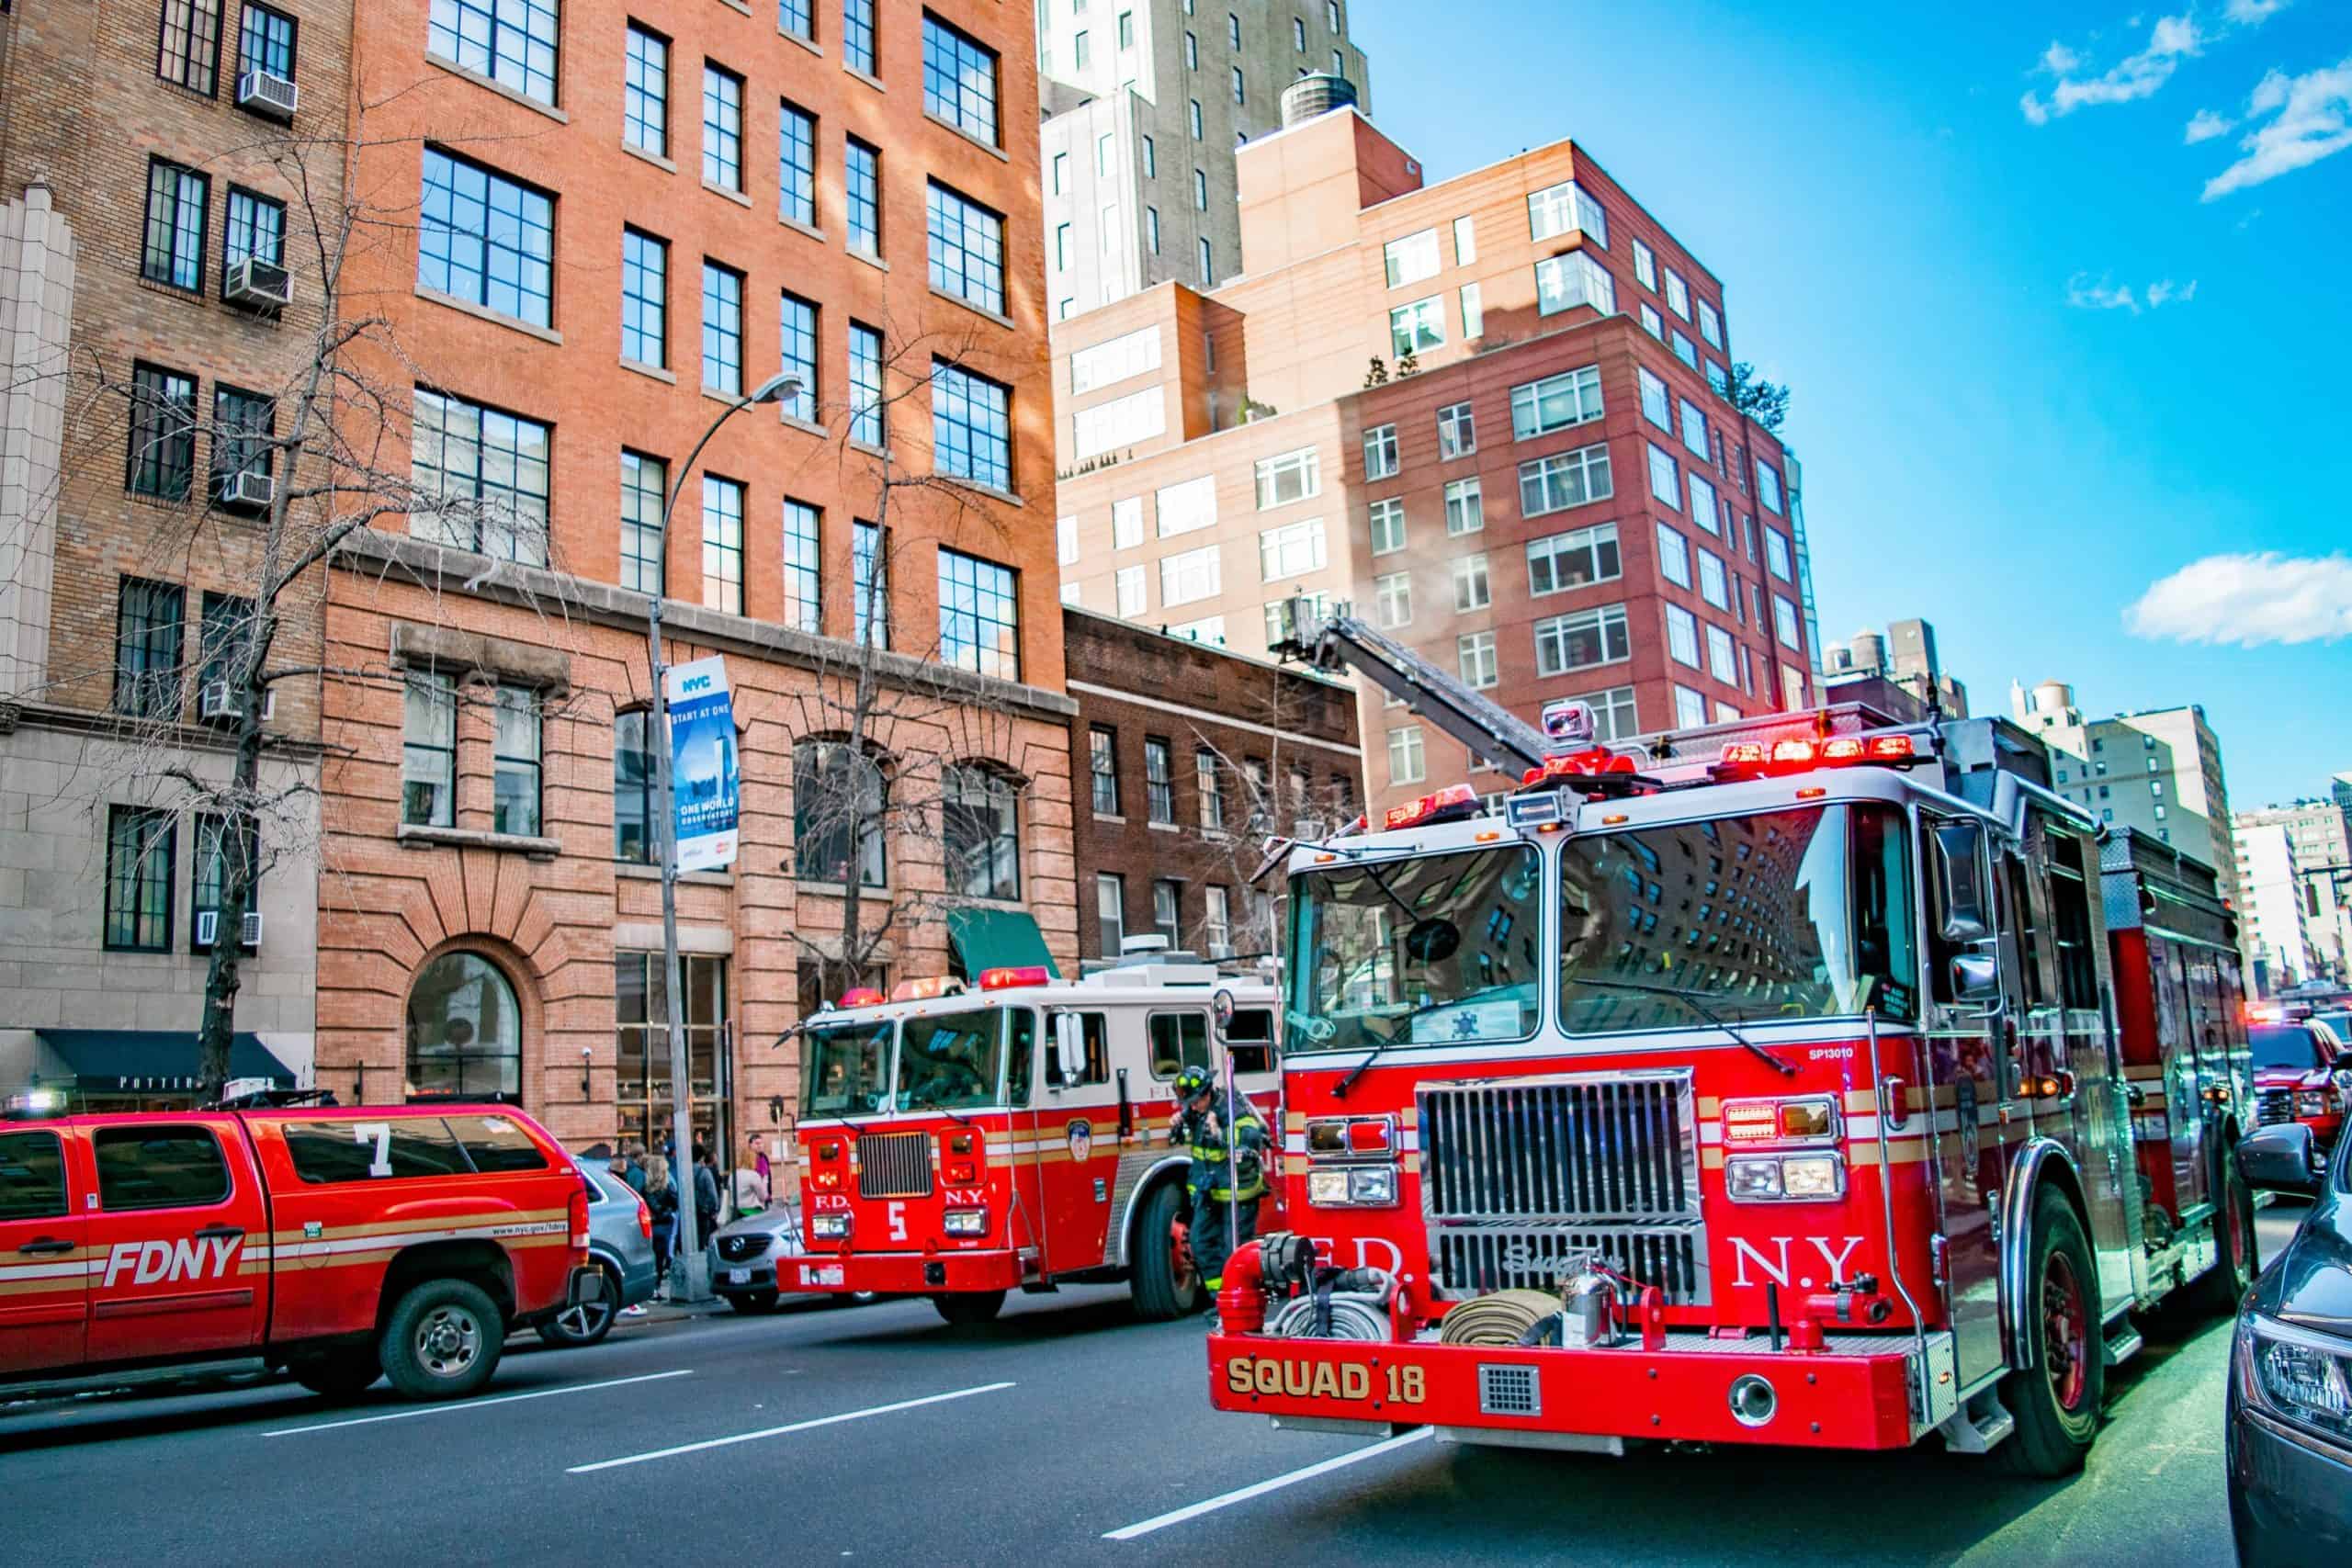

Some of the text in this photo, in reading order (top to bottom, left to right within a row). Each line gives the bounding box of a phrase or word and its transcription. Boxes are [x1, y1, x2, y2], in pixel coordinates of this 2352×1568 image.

[683, 675, 710, 692] NYC
[673, 704, 729, 725] START AT ONE
[681, 796, 734, 816] ONE WORLD
[1808, 1047, 1854, 1060] SP13010
[353, 1123, 392, 1177] 7
[815, 1196, 851, 1209] F.D.
[945, 1190, 988, 1204] N.Y.
[888, 1201, 908, 1241] 5
[103, 1234, 244, 1287] FDNY
[1227, 1358, 1426, 1404] SQUAD 18
